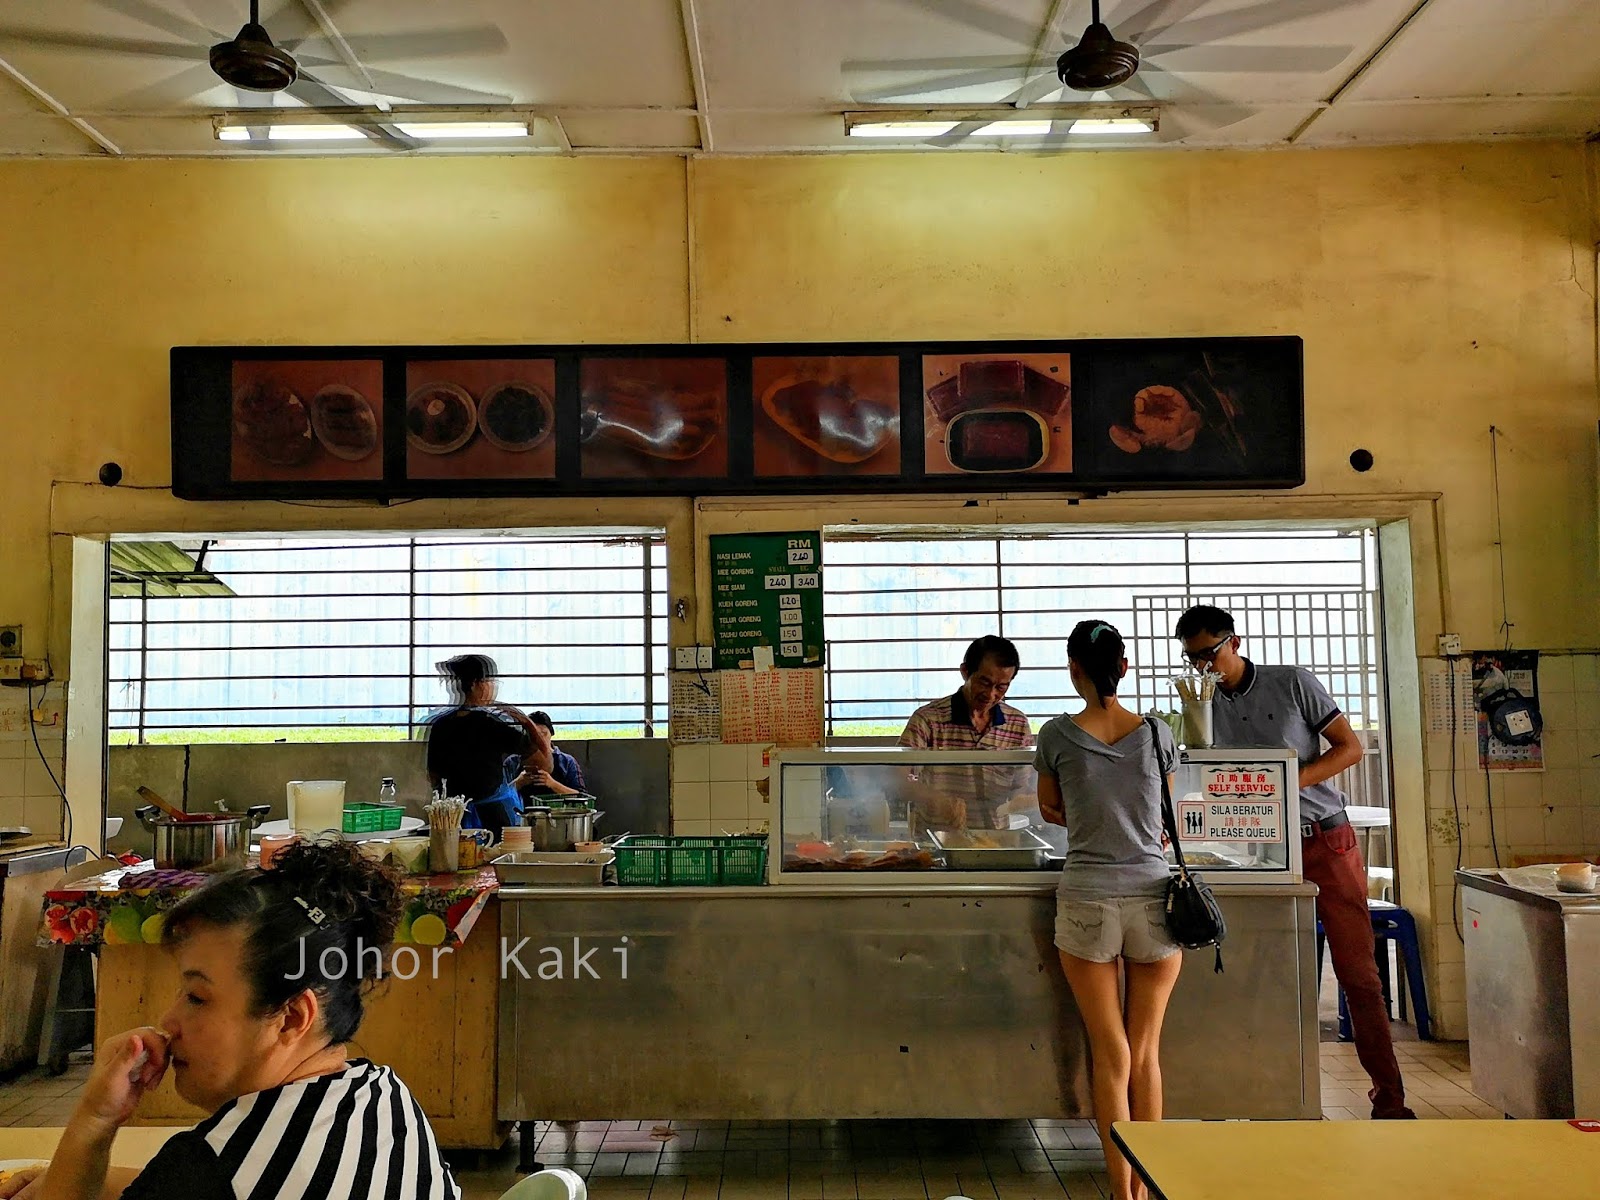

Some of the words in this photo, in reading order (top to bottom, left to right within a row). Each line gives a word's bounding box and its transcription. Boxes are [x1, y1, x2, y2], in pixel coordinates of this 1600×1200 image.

[787, 539, 811, 549] RM
[731, 552, 752, 560] LEMAK
[730, 583, 746, 591] SIAM
[719, 616, 737, 624] TELUR
[738, 615, 761, 623] GORENG
[738, 630, 762, 638] GORENG
[735, 647, 751, 655] BOLA
[1216, 773, 1266, 783] 自助服務
[1208, 784, 1231, 792] SELF
[1234, 784, 1276, 792] SERVICE
[1211, 805, 1231, 815] SILA
[1233, 805, 1274, 815] BERATUR
[1224, 817, 1261, 827] 請排隊
[1210, 828, 1244, 838] PLEASE
[1245, 827, 1276, 838] QUEUE
